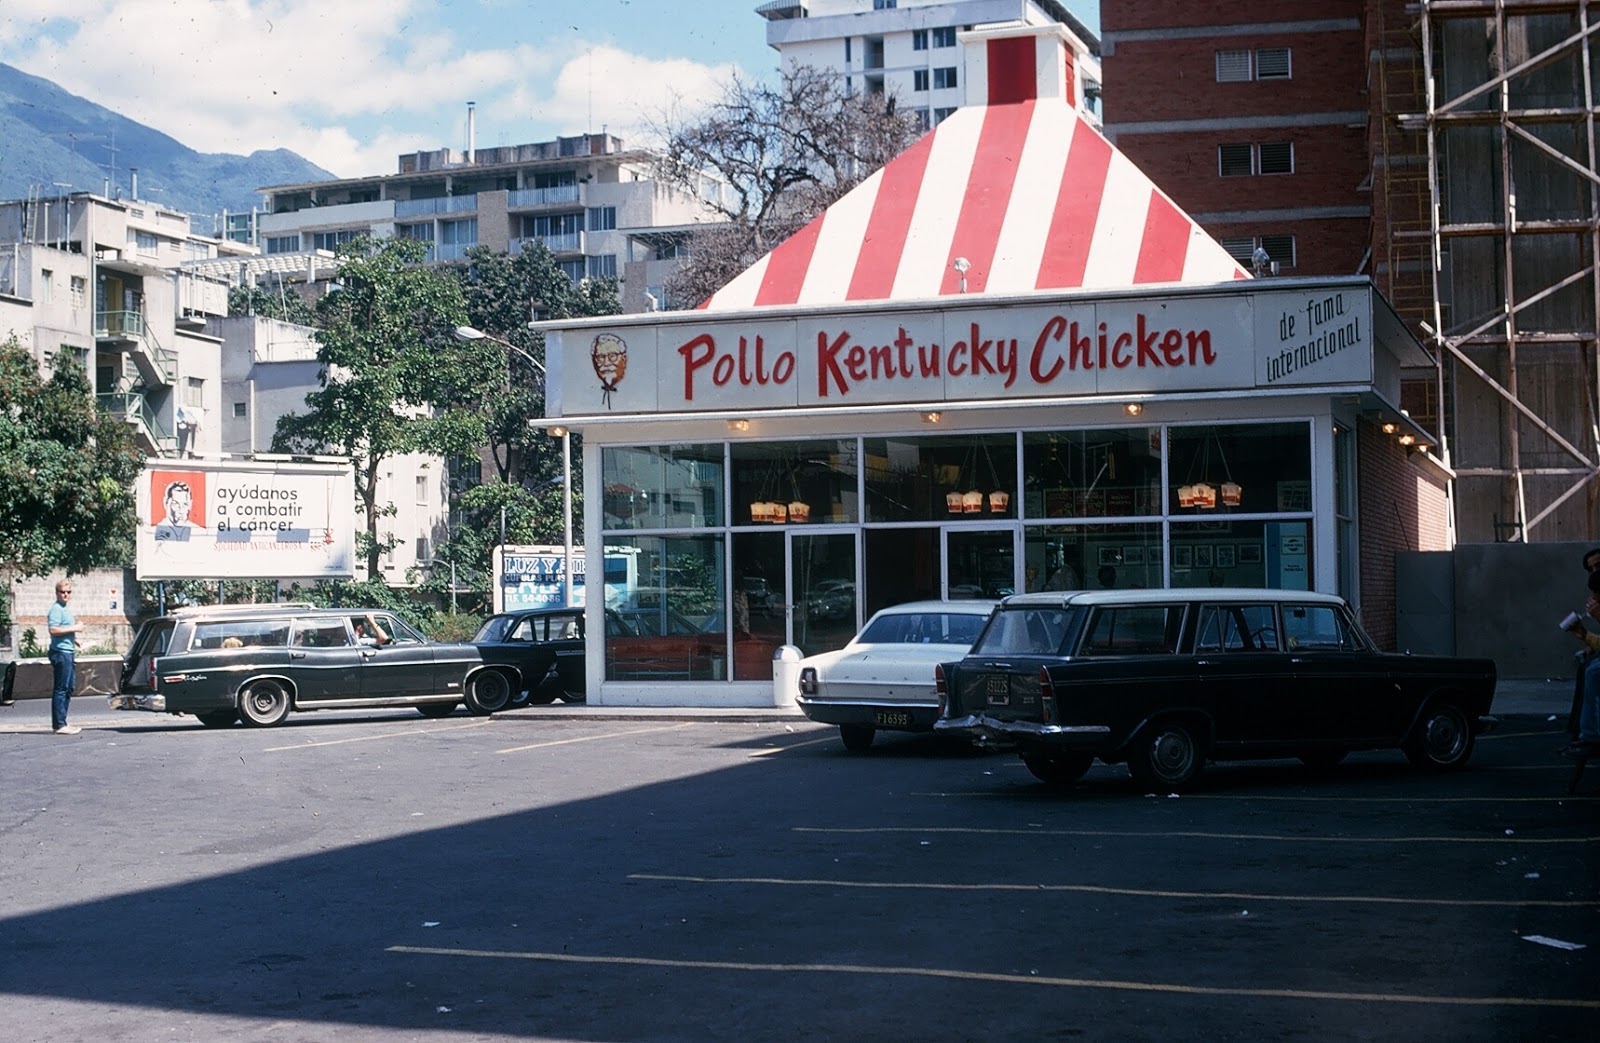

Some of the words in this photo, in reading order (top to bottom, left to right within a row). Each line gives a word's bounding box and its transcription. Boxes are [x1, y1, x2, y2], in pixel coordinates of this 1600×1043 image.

[1280, 312, 1295, 341] de
[1306, 293, 1344, 335] fama
[678, 333, 796, 401] Pollo
[817, 326, 1018, 397] Kentucky
[1029, 313, 1217, 385] Chicken
[1266, 317, 1361, 383] internacional
[217, 484, 298, 503] ayúdanos
[217, 505, 227, 515] a
[236, 501, 303, 516] combatir
[217, 517, 231, 532] el
[239, 517, 294, 532] cáncer
[504, 557, 540, 574] LUZ
[541, 557, 557, 574] Y
[504, 581, 560, 594] STYLE
